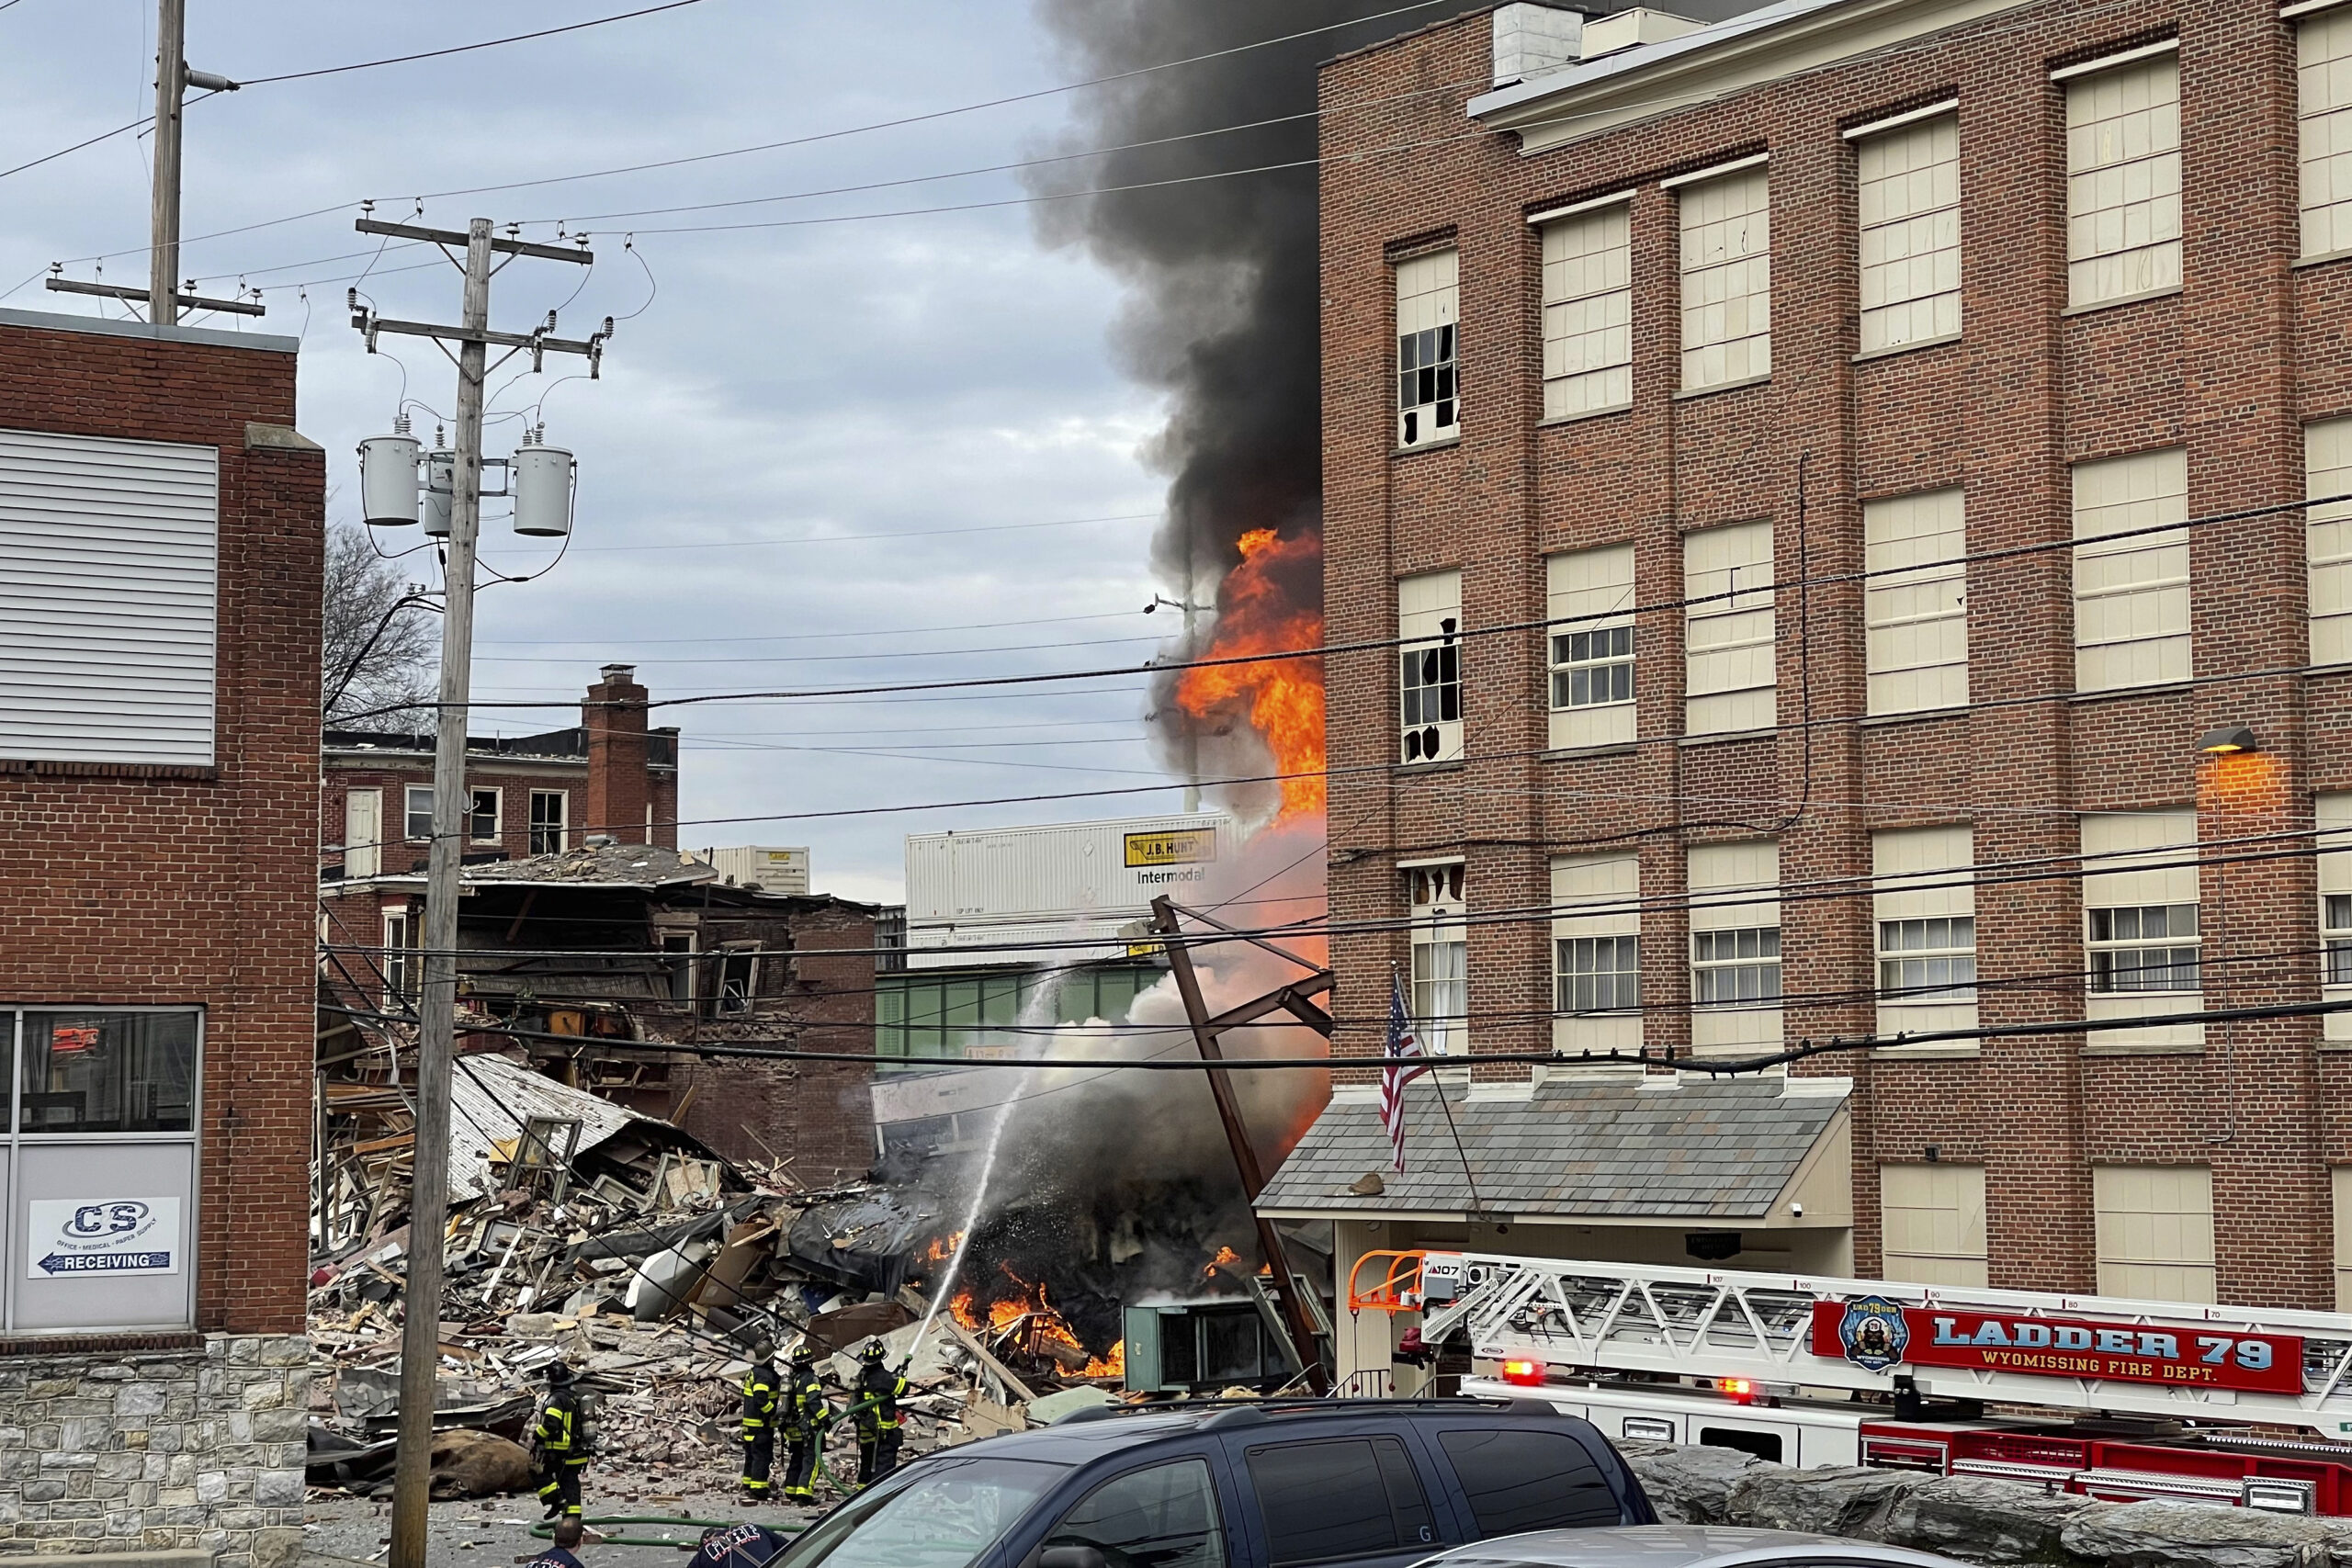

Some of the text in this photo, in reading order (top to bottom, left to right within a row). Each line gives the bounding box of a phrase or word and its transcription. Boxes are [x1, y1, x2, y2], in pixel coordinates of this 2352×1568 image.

[1167, 841, 1194, 854] HUNT
[1137, 866, 1205, 884] Intermodal
[56, 1217, 157, 1250] OFFICE MEDICAL PAPER SUPPLY
[64, 1254, 150, 1269] RECEIVING
[1932, 1316, 2273, 1371] LADDER 79
[1981, 1349, 2218, 1382] WYOMISSING FIRE DEPT.
[1419, 1526, 1430, 1542] G
